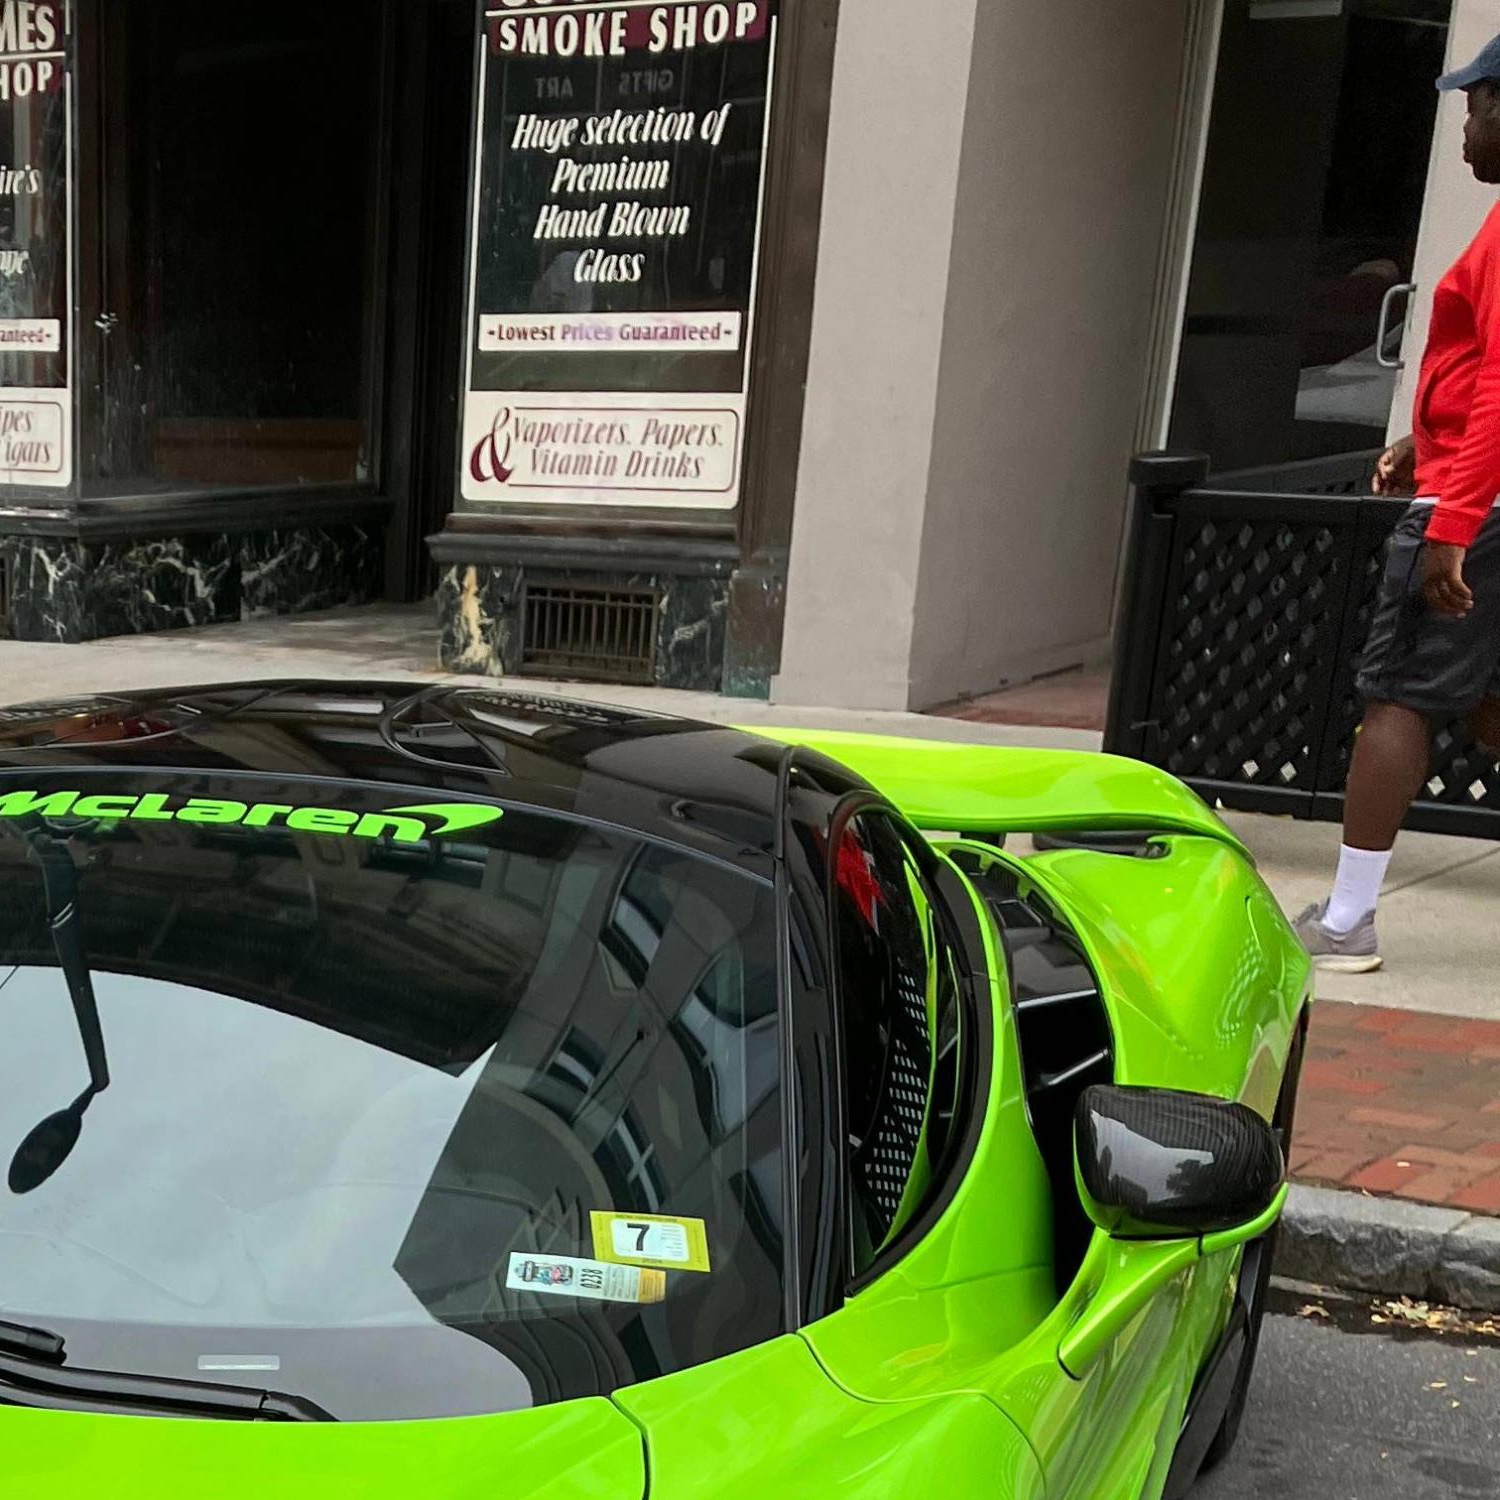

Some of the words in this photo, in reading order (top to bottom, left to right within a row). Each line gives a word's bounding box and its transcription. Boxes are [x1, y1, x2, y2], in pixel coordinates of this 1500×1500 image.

[500, 11, 627, 56] SMOKE
[649, 2, 756, 53] SHOP
[511, 114, 579, 153] Huge
[580, 107, 695, 145] selection
[700, 102, 732, 146] of
[551, 155, 670, 193] Premium
[533, 202, 608, 239] Hand
[608, 201, 691, 237] Blown
[574, 249, 646, 283] Glass
[561, 325, 613, 341] Prices
[470, 407, 513, 483] &
[531, 448, 618, 476] Vitamin
[624, 449, 704, 479] Drinks
[627, 1222, 650, 1252] 7
[579, 1267, 604, 1290] 0238
